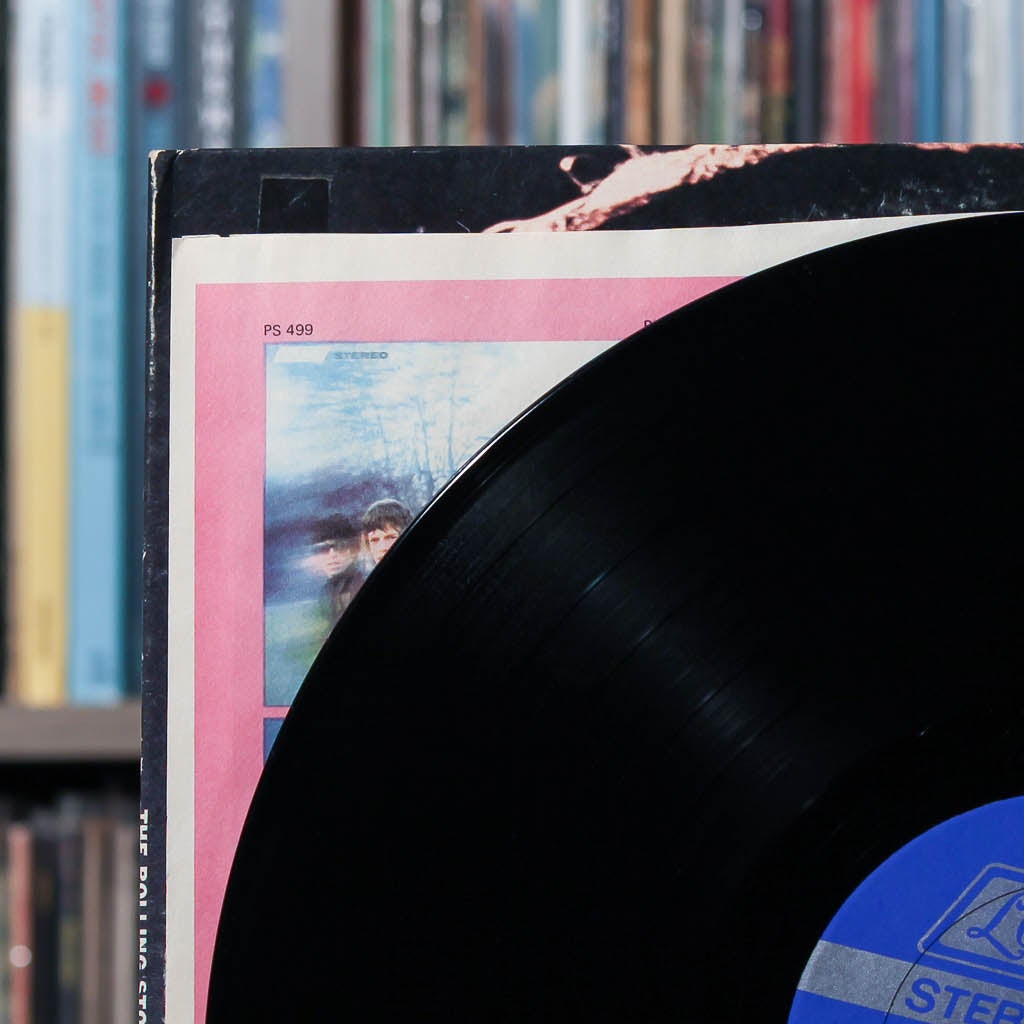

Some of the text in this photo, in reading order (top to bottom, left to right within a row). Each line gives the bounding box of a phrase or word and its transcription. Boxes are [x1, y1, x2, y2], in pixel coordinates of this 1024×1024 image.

[264, 324, 313, 336] PS 499
[335, 351, 388, 359] STEREO
